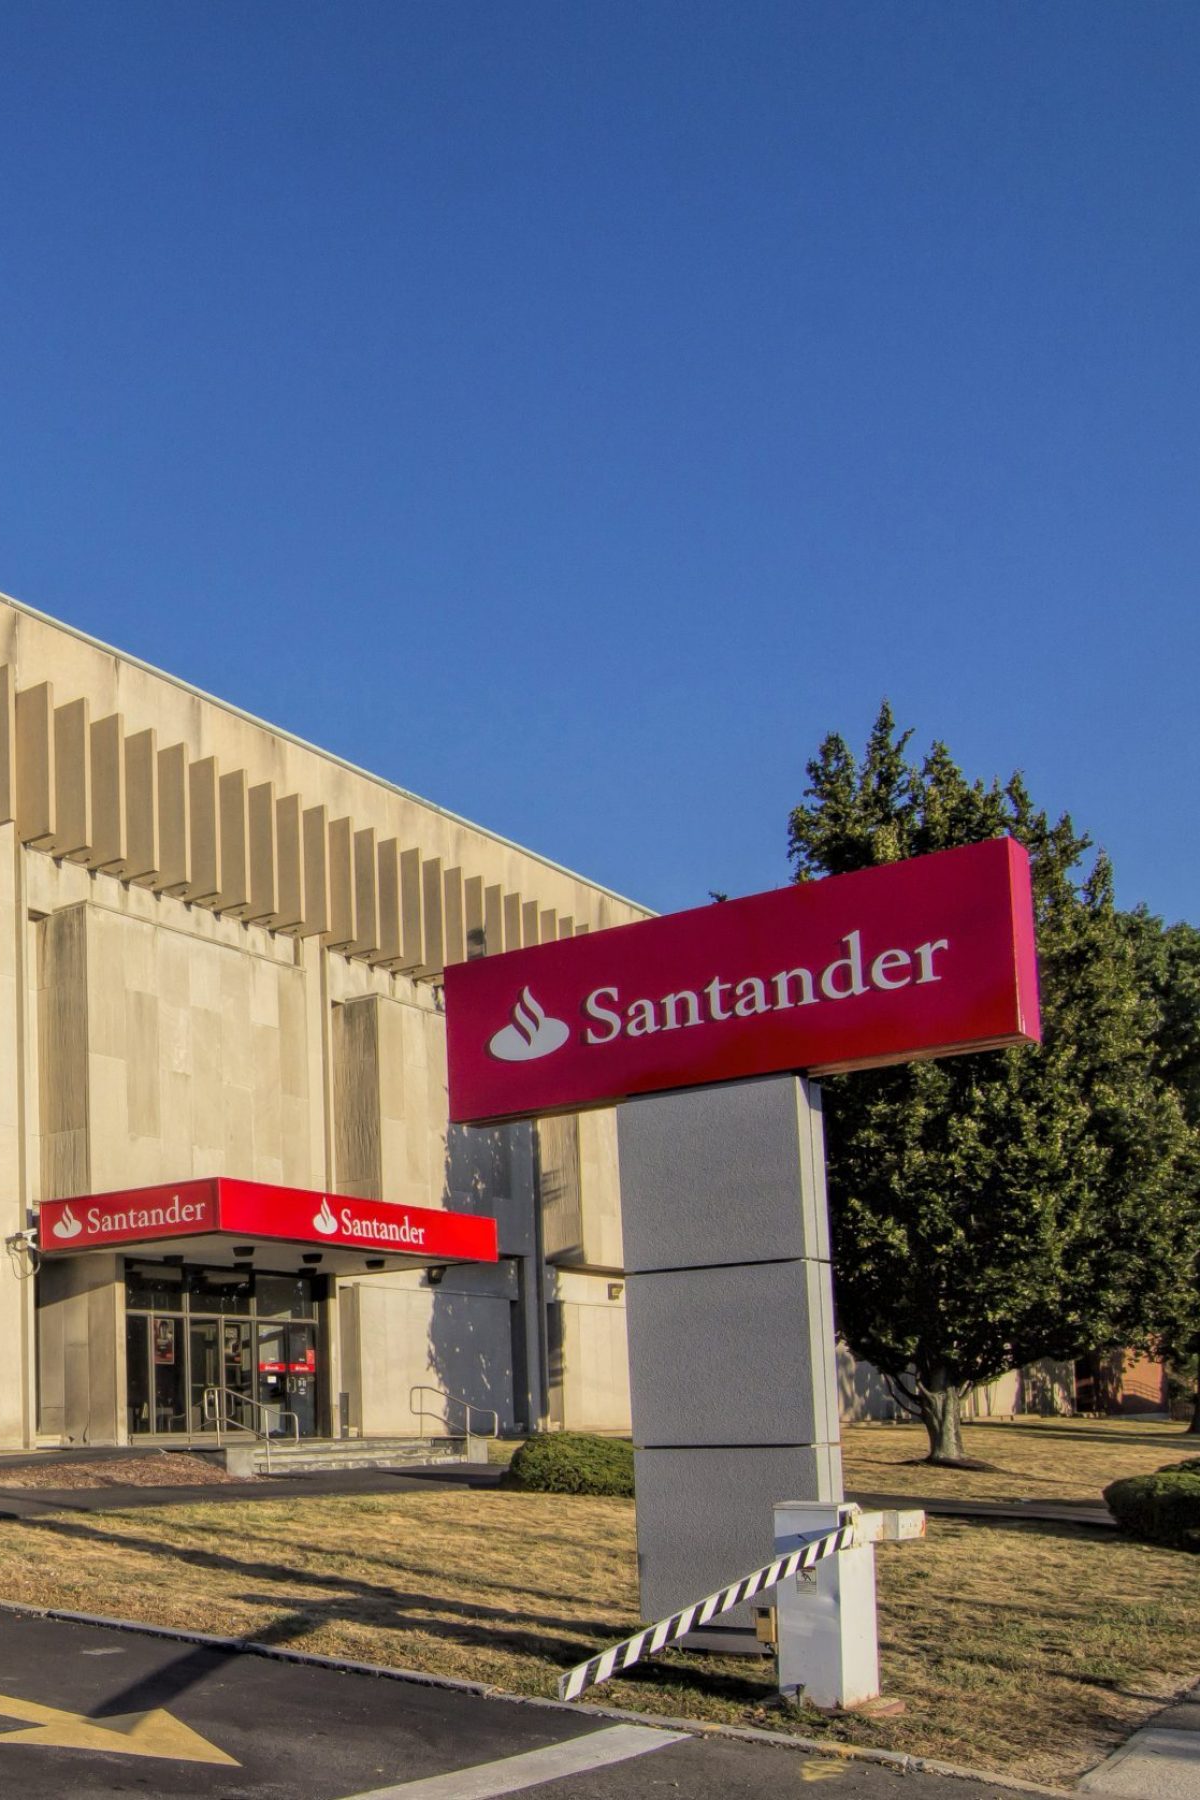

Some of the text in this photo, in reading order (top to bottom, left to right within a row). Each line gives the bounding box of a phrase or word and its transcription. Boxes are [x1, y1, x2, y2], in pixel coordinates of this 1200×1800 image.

[585, 929, 949, 1044] Santander
[87, 1195, 205, 1234] Santander
[340, 1208, 425, 1245] Santander
